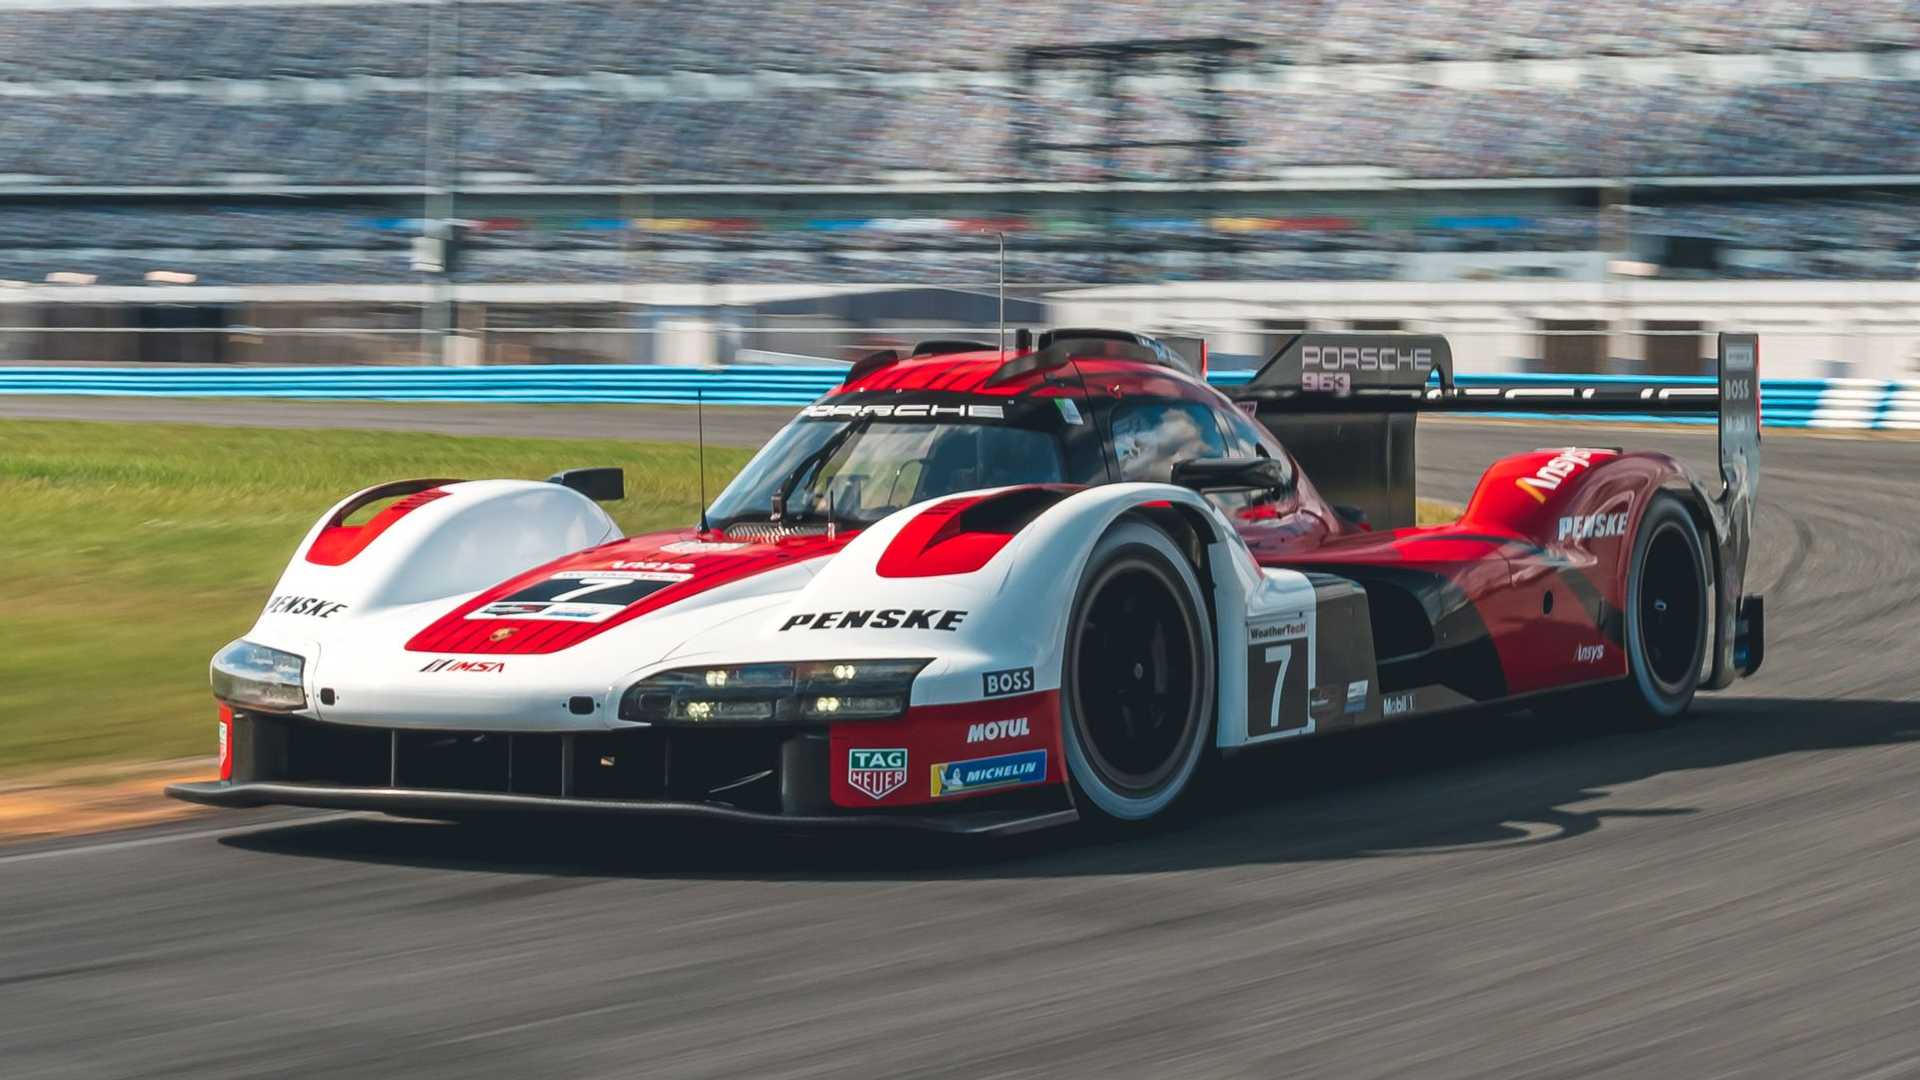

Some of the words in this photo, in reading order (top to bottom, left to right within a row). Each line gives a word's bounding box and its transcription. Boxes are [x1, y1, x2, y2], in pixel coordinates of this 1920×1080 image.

[1302, 346, 1431, 371] PORSCHE
[1302, 372, 1350, 391] 963
[1725, 380, 1749, 400] BOSS
[1515, 446, 1592, 504] Ansys
[1558, 511, 1629, 541] PENSKE
[550, 578, 634, 602] 7
[779, 609, 968, 632] PENSKE
[1250, 623, 1306, 639] WeatherTech
[1573, 643, 1604, 664] Ansys
[446, 661, 505, 672] IMSA
[987, 670, 1031, 693] BOSS
[1265, 644, 1292, 728] 7
[1383, 696, 1407, 715] Mobil
[966, 717, 1030, 743] MOTUL
[855, 752, 902, 767] TAG
[852, 770, 904, 794] HEUER
[966, 761, 1037, 783] MICHELIN
